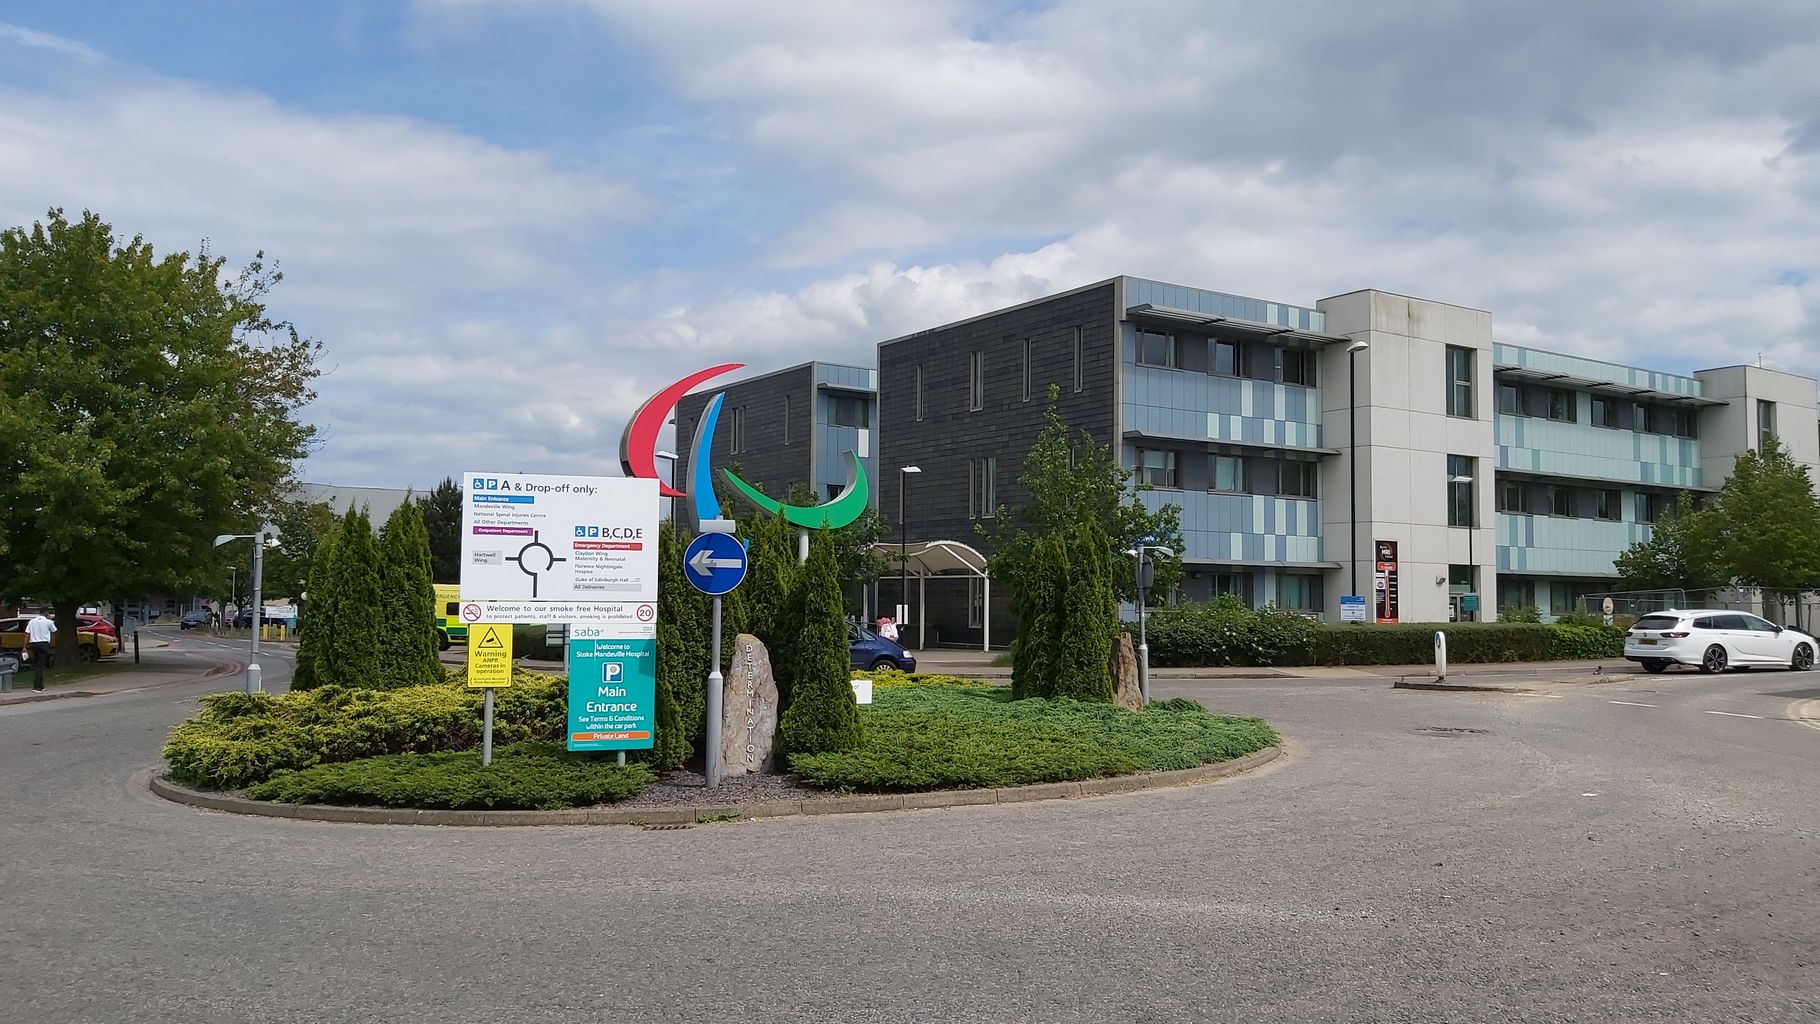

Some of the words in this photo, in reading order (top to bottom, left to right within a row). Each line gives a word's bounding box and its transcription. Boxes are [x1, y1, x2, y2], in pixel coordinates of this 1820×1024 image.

[501, 480, 510, 490] A
[514, 483, 522, 491] &
[525, 483, 570, 494] Drop-off
[572, 485, 598, 495] only:
[602, 528, 642, 539] B,C,D,E
[593, 605, 623, 613] Hospital
[575, 627, 600, 636] saba
[475, 650, 507, 658] Warning
[598, 686, 626, 697] Main
[586, 702, 637, 712] Entrance
